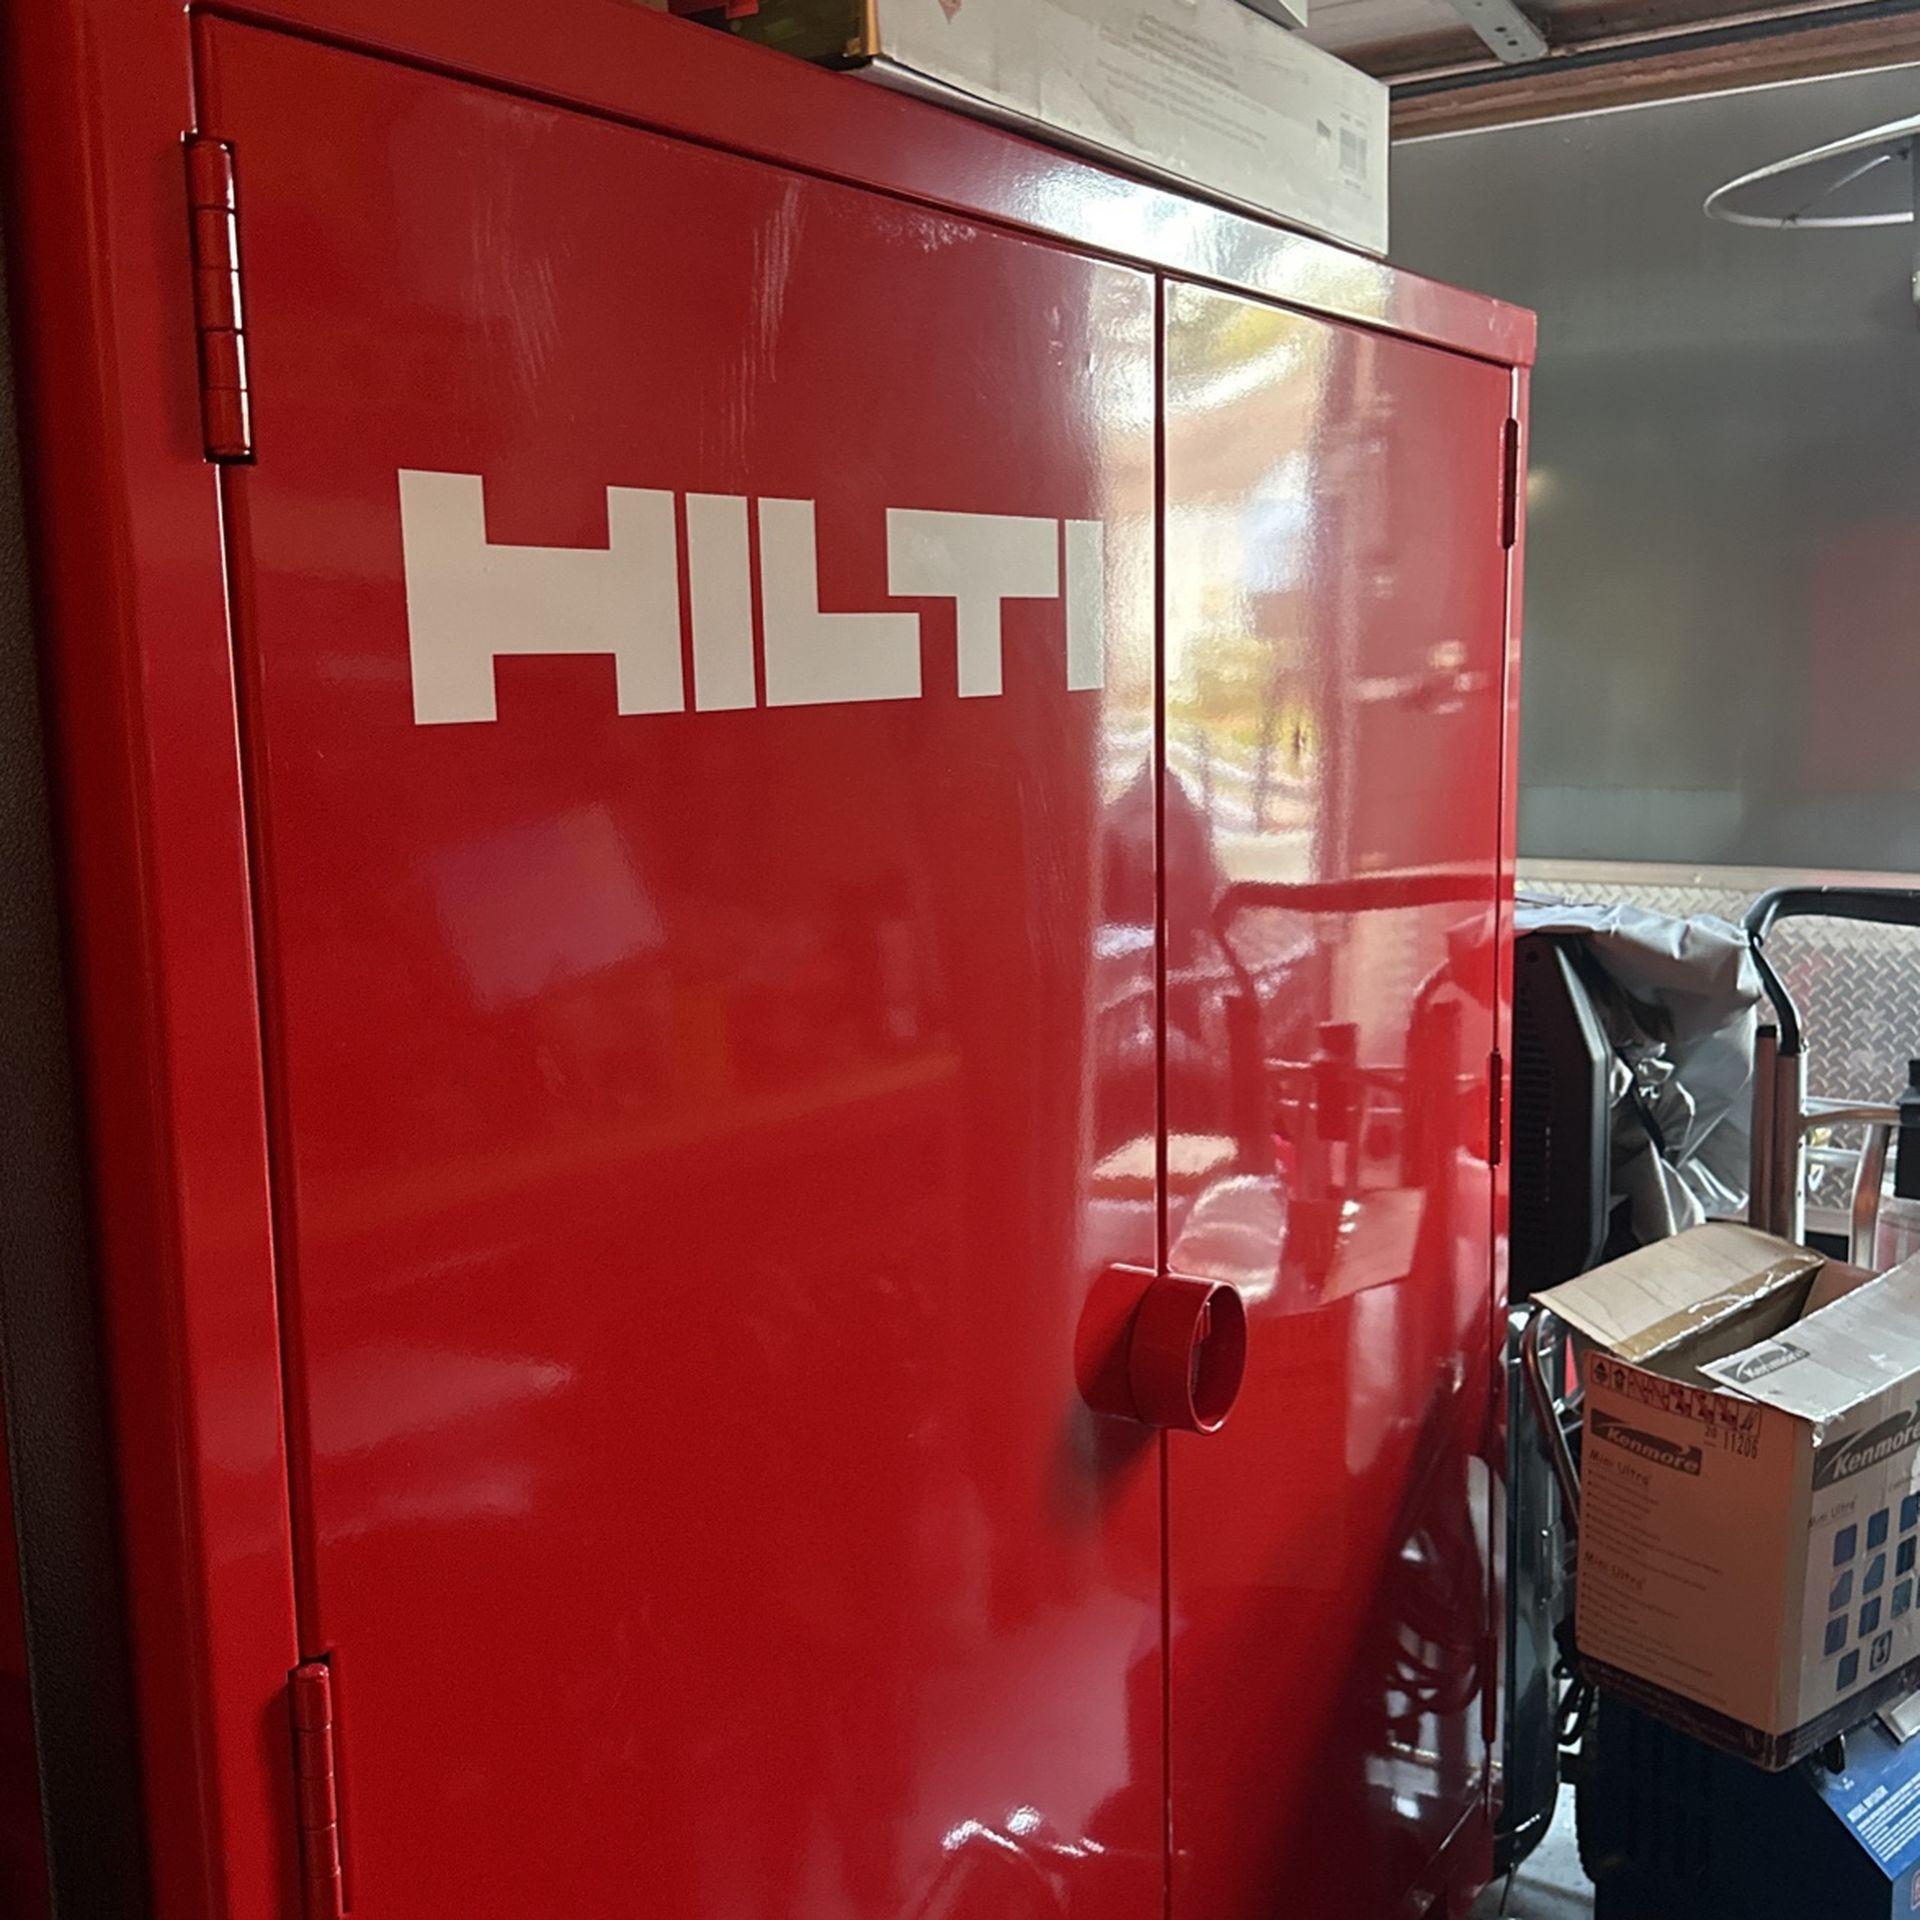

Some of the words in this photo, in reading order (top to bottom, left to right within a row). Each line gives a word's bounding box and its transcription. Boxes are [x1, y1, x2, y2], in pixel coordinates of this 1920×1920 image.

[398, 468, 1105, 726] HILTI
[1607, 1426, 1700, 1474] Kenmore
[1832, 1420, 1920, 1481] Kenmore
